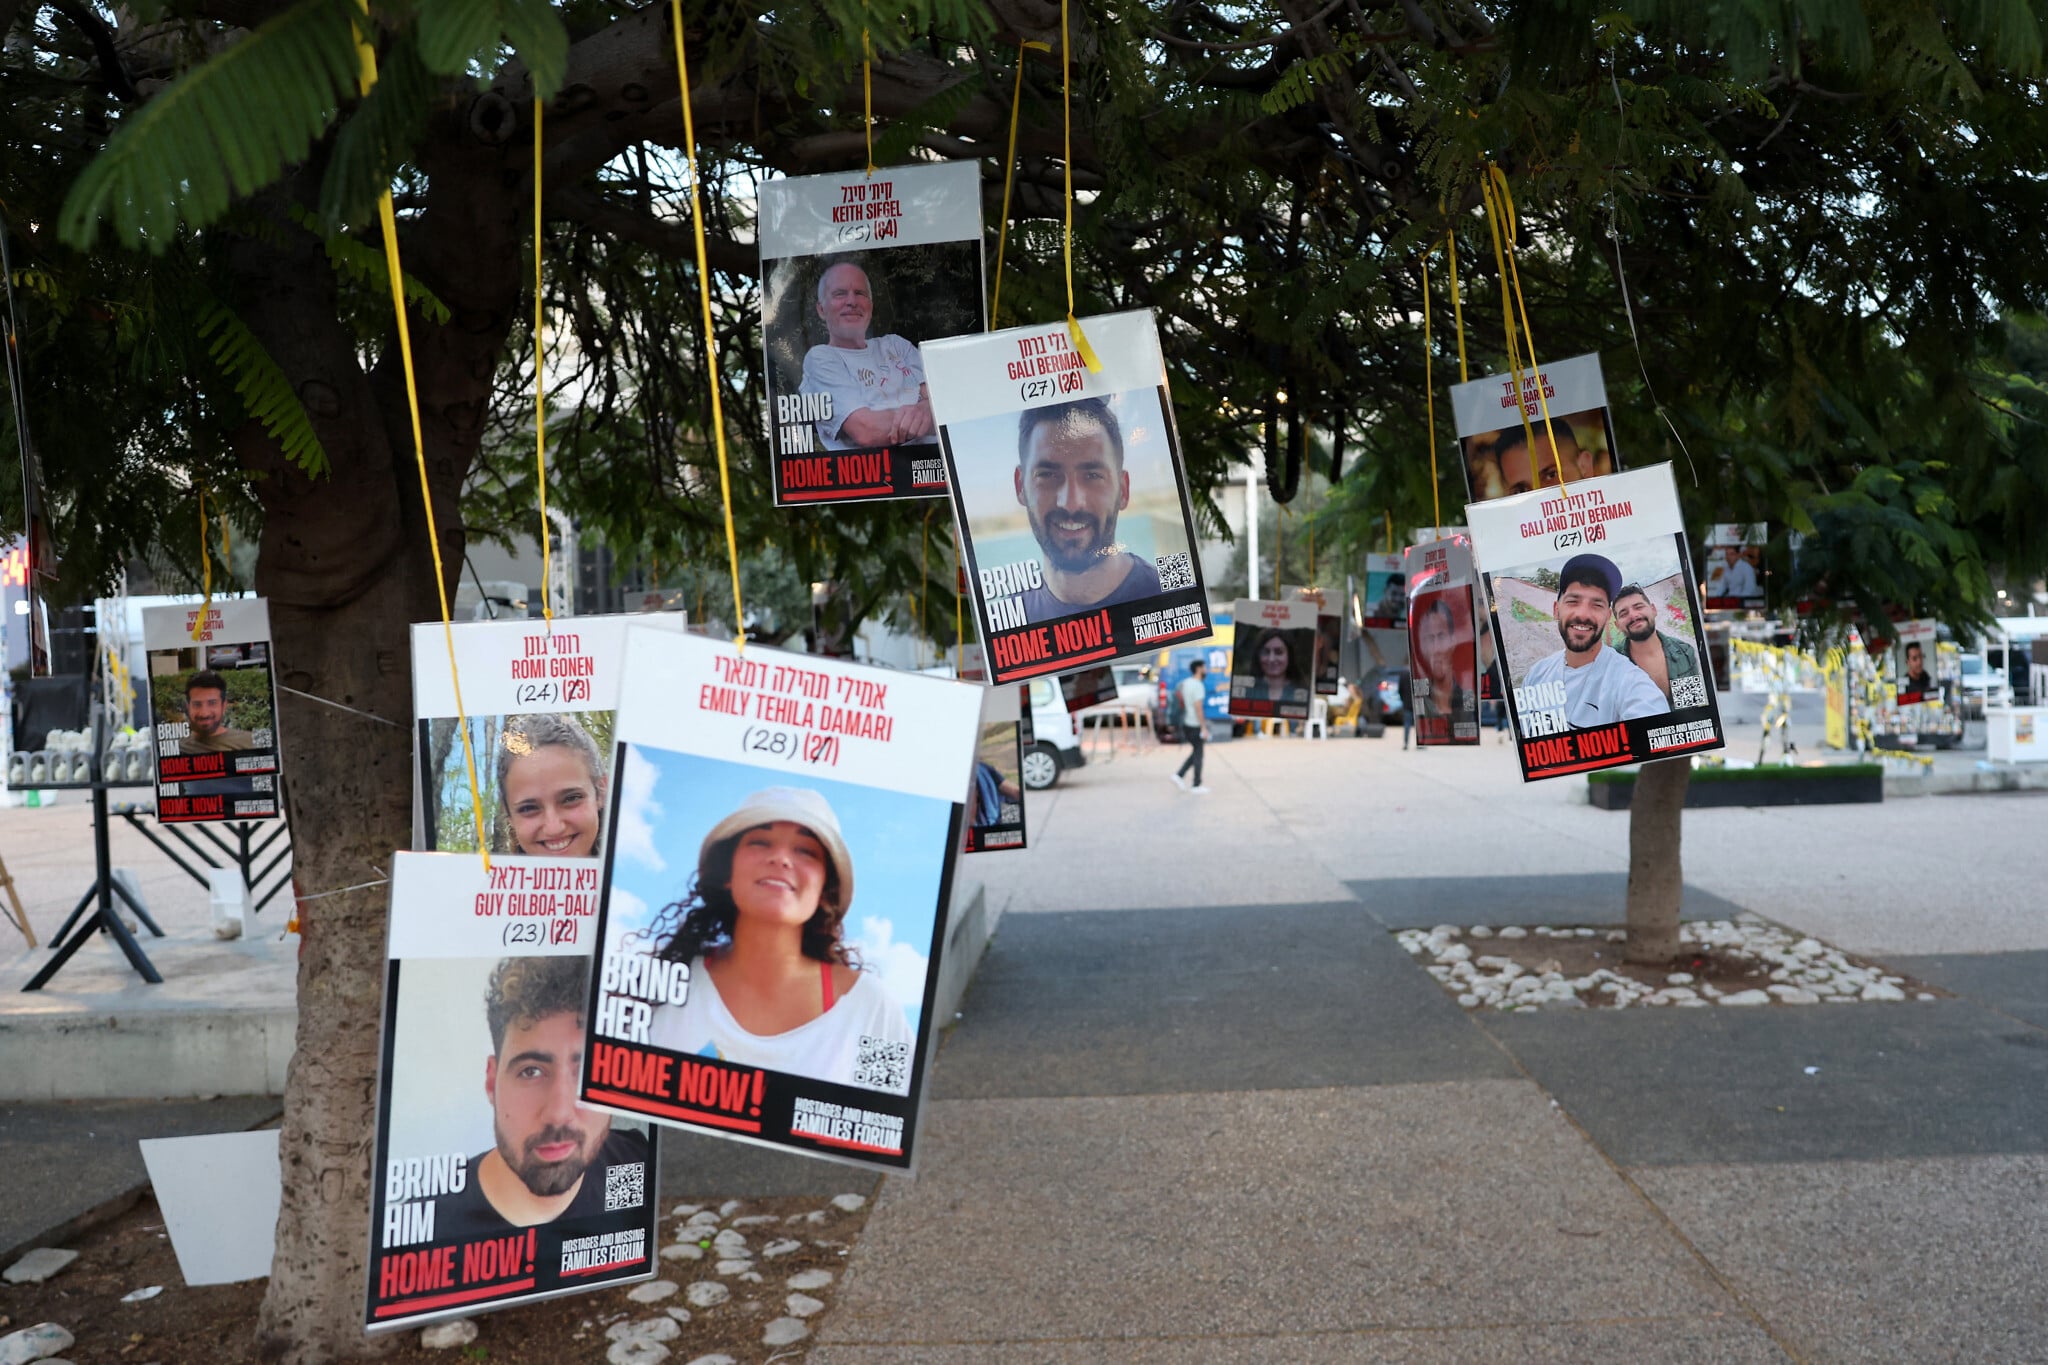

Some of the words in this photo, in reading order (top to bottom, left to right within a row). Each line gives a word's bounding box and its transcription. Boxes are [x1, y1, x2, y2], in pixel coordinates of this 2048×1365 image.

[841, 186, 866, 204] סיגל
[832, 204, 864, 223] KEITH
[866, 200, 902, 219] SIEGEL
[1018, 336, 1046, 359] ברמן
[1050, 332, 1068, 350] גלי
[1007, 360, 1036, 380] GALI
[1020, 378, 1056, 401] (27)
[1500, 394, 1519, 408] URIE
[1523, 385, 1555, 404] BARCH
[778, 392, 833, 424] BRING
[1524, 402, 1538, 416] 35)
[780, 424, 814, 454] HIM
[782, 456, 834, 488] HOME
[837, 449, 892, 485] NOW!
[912, 458, 942, 470] HOSTAGES
[912, 468, 945, 484] FAMILIE
[1540, 498, 1566, 518] ברמן
[1587, 490, 1606, 506] גלי
[1520, 520, 1544, 538] GALI
[1546, 516, 1568, 534] AND
[1568, 512, 1586, 528] ZIV
[1588, 501, 1633, 524] BERMAN
[1554, 530, 1582, 551] (27)
[978, 558, 1043, 600] BRING
[984, 596, 1028, 633] HIM
[1132, 610, 1162, 626] HOSTAGES
[1162, 608, 1175, 620] AND
[1174, 602, 1202, 616] MISSING
[1134, 620, 1172, 640] FAMILIES
[1173, 612, 1204, 632] FORUM
[524, 636, 548, 658] גונן
[553, 634, 580, 654] רומי
[992, 627, 1054, 669] HOME
[1053, 610, 1114, 657] NOW!
[512, 659, 546, 679] ROMI
[550, 656, 594, 678] GONEN
[714, 656, 768, 689] דמארי
[516, 682, 558, 705] (24)
[772, 664, 830, 700] תהילה
[836, 675, 888, 710] אמילי
[1512, 680, 1567, 713] BRING
[699, 684, 752, 716] EMILY
[756, 694, 814, 728] TEHILA
[820, 706, 894, 742] DAMARI
[1518, 707, 1570, 739] THEM
[157, 722, 190, 740] BRING
[1646, 726, 1676, 738] HOSTAGES
[1676, 723, 1688, 732] AND
[1688, 718, 1712, 730] MISSING
[1648, 732, 1686, 750] FAMILIES
[1686, 727, 1714, 744] FORUM
[160, 740, 180, 757] HIM
[742, 726, 798, 760] (28)
[1524, 736, 1576, 768] HOME
[1577, 723, 1631, 760] NOW!
[162, 757, 192, 775] HOME
[193, 752, 224, 772] NOW!
[160, 782, 180, 797] HIM
[160, 798, 190, 814] HOME
[192, 795, 224, 813] NOW!
[490, 864, 572, 891] גלבוע-דלאל
[576, 868, 598, 890] גיא
[474, 893, 504, 917] GUY
[508, 893, 598, 917] GILBOA-DALA
[502, 922, 546, 946] (23)
[602, 952, 691, 1006] BRING
[594, 994, 652, 1044] HER
[591, 1042, 674, 1098] HOME
[678, 1060, 765, 1118] NOW!
[794, 1096, 842, 1119] HOSTAGES
[842, 1106, 862, 1122] AND
[862, 1110, 904, 1131] MISSING
[792, 1110, 853, 1140] FAMILIES
[852, 1122, 902, 1151] FORUM
[386, 1152, 468, 1202] BRING
[382, 1200, 436, 1250] HIM
[562, 1235, 600, 1254] HOSTAGES
[600, 1233, 614, 1247] AND
[614, 1228, 646, 1244] MISSING
[379, 1246, 458, 1299] HOME
[462, 1228, 537, 1285] NOW!
[561, 1246, 608, 1272] FAMILIES
[608, 1240, 645, 1264] FORUM
